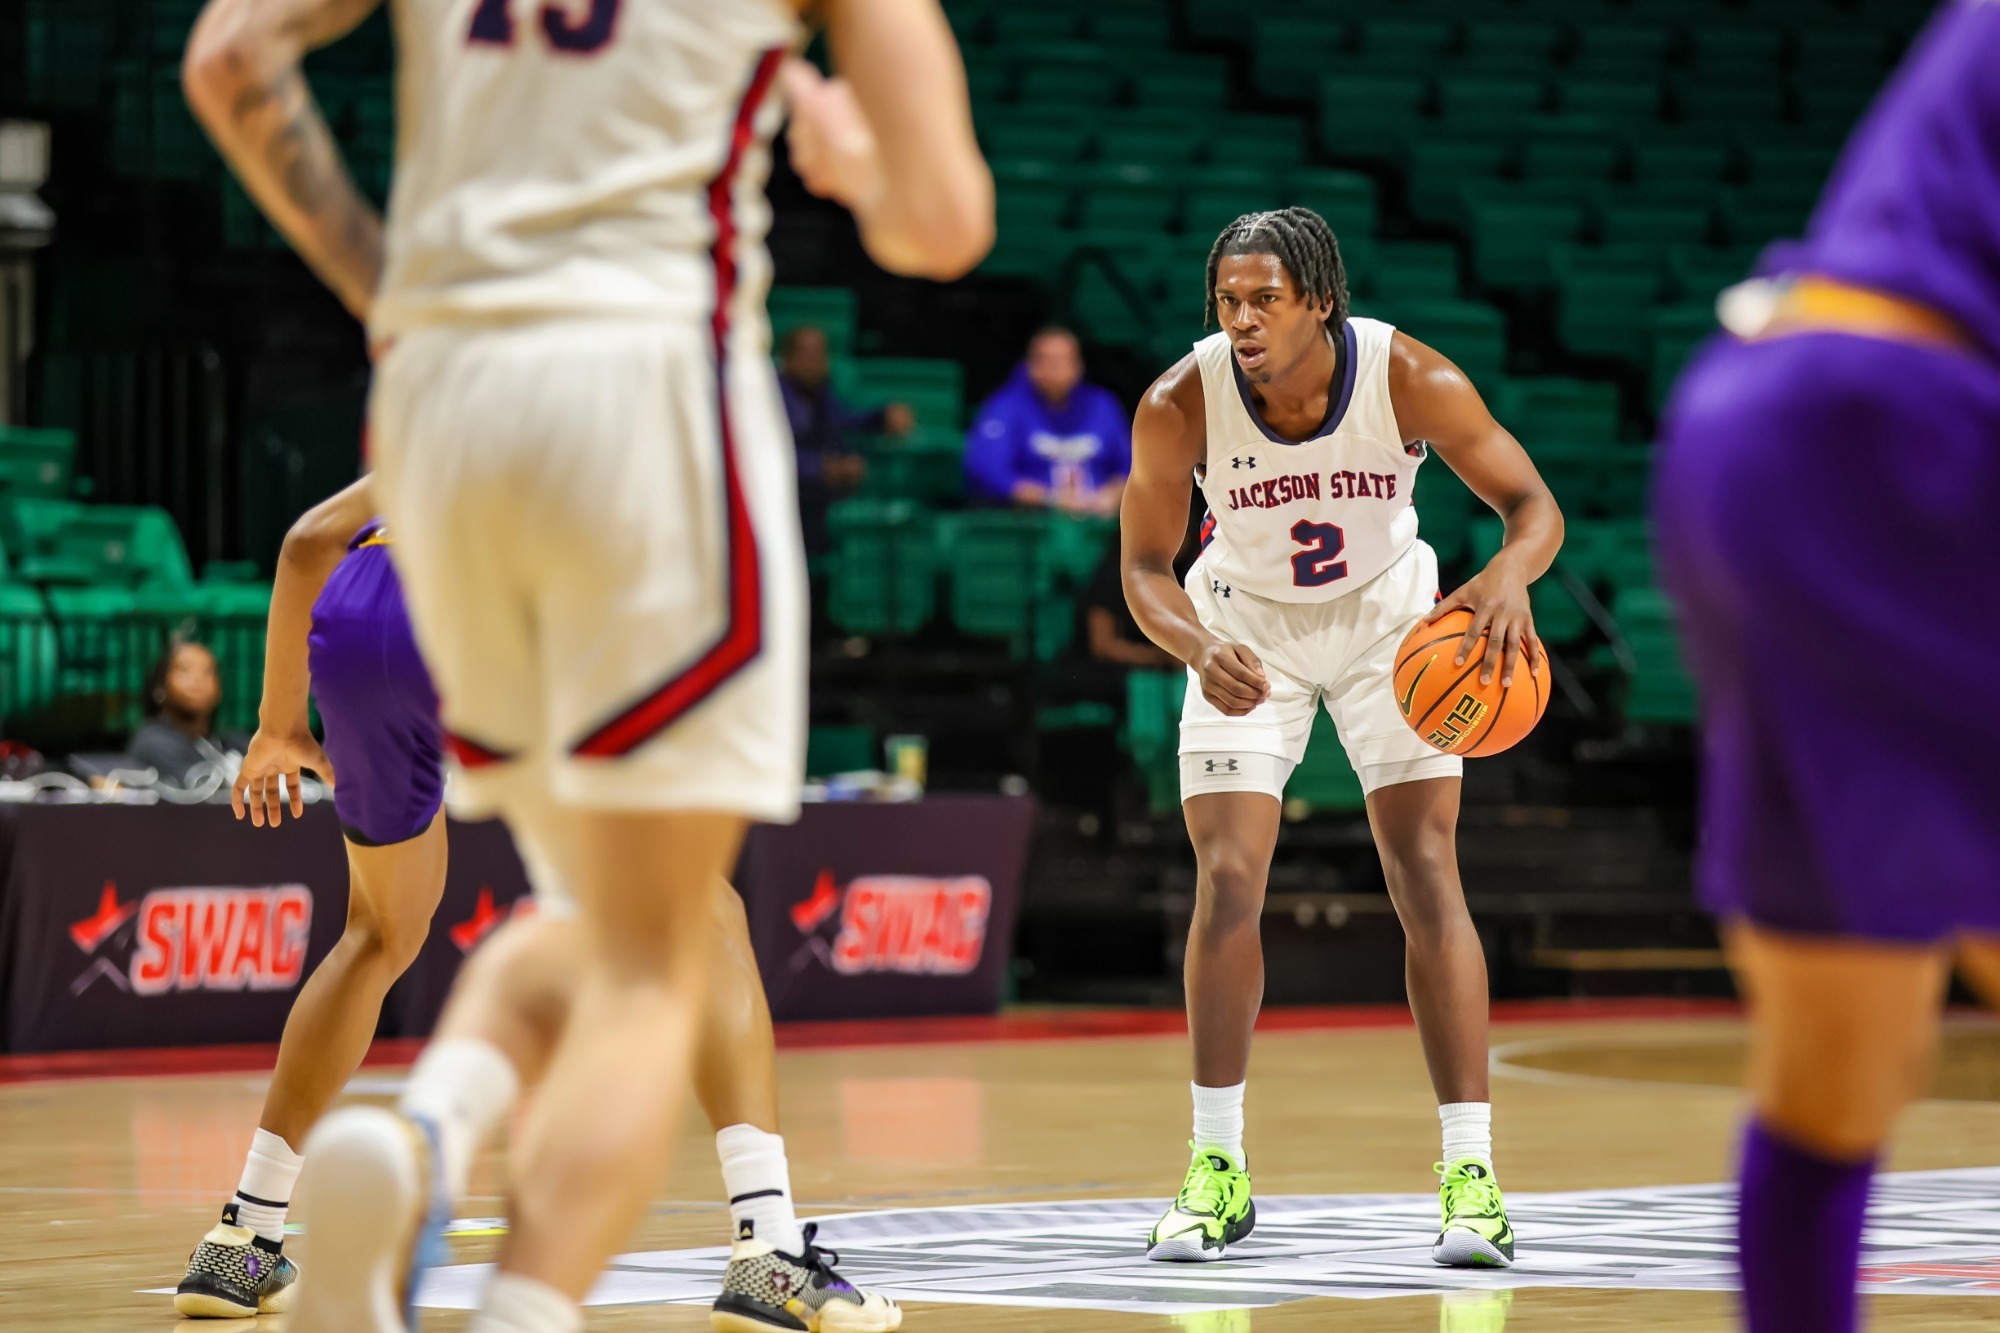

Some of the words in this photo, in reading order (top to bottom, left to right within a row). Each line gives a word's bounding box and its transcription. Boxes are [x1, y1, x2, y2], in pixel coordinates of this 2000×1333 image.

[1228, 472, 1320, 511] JACKSON
[1330, 470, 1397, 501] STATE
[1290, 518, 1348, 587] 2
[1426, 692, 1483, 749] ELITE
[133, 885, 312, 993] SWAC
